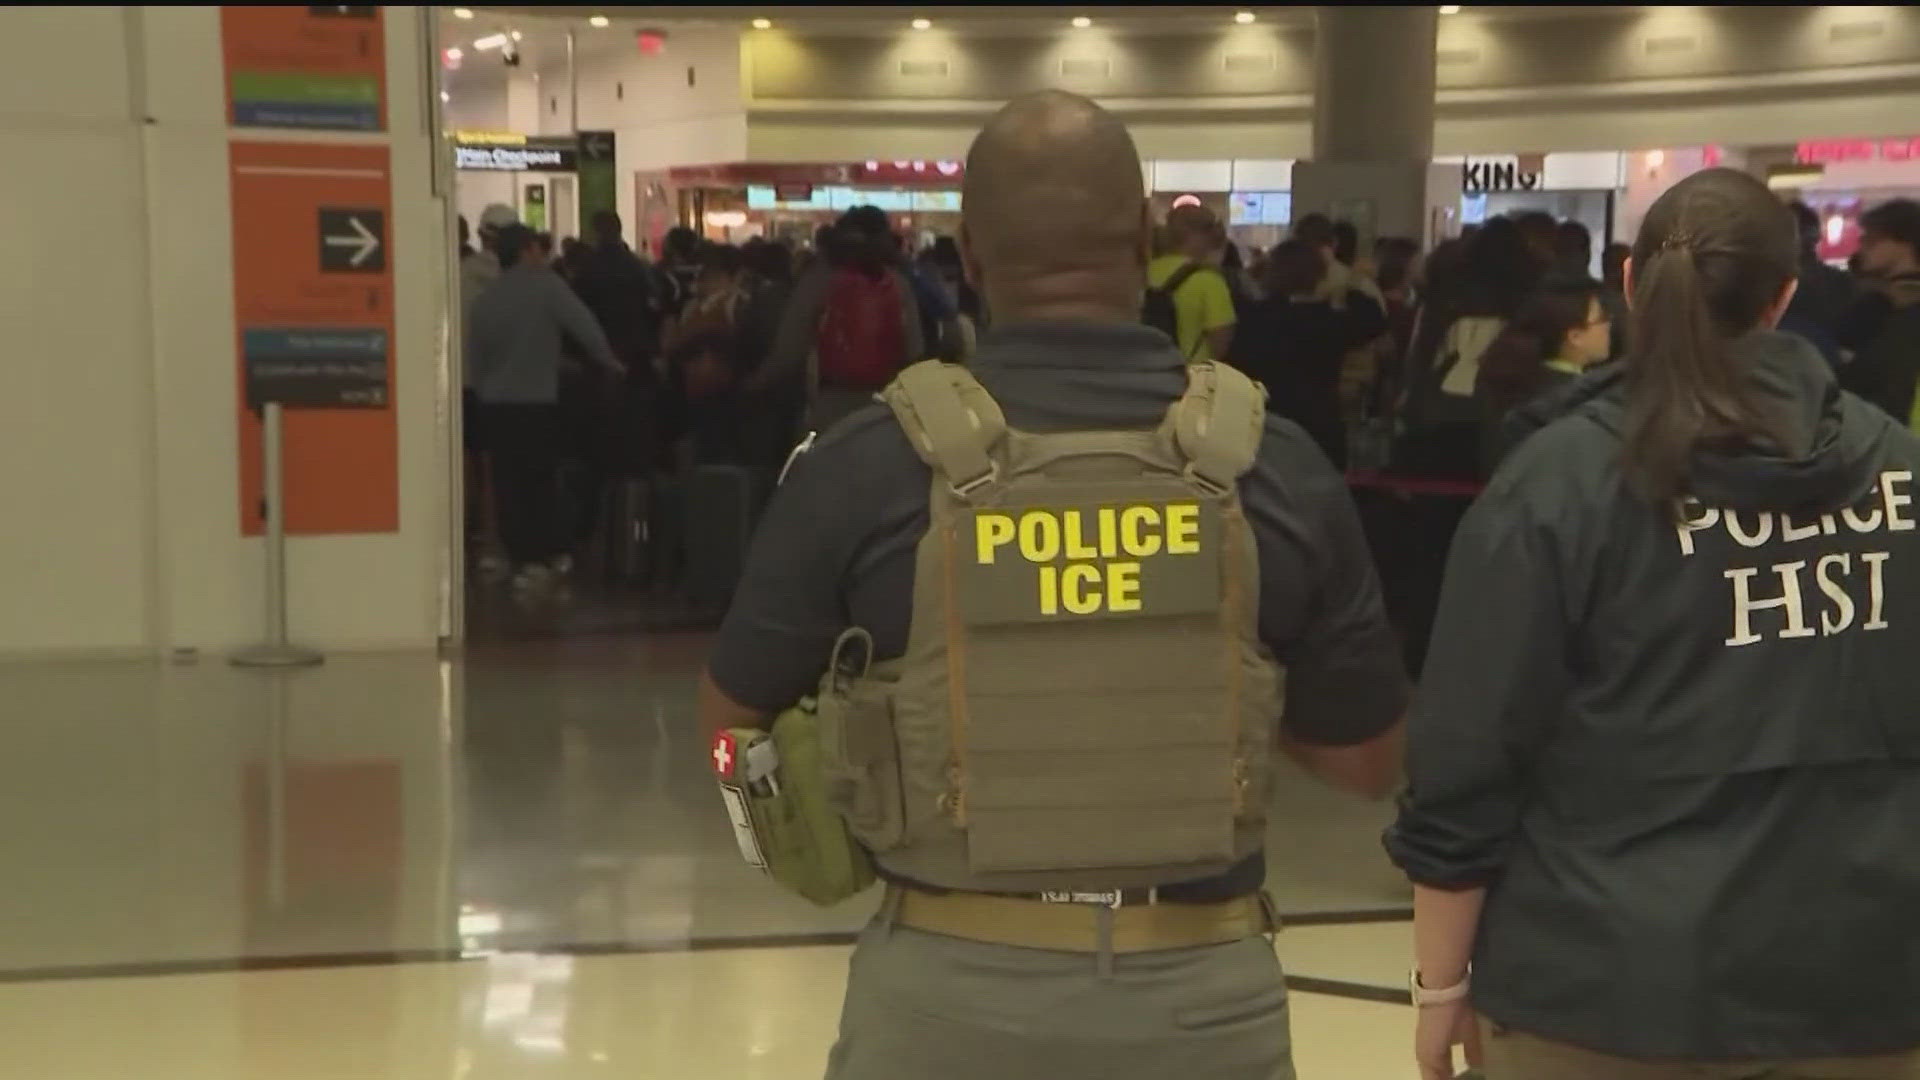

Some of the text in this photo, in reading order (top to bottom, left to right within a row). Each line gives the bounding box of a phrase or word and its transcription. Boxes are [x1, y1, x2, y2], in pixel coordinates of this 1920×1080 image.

[975, 504, 1201, 565] POLICE
[1039, 561, 1142, 615] ICE
[1723, 551, 1890, 647] HSI
